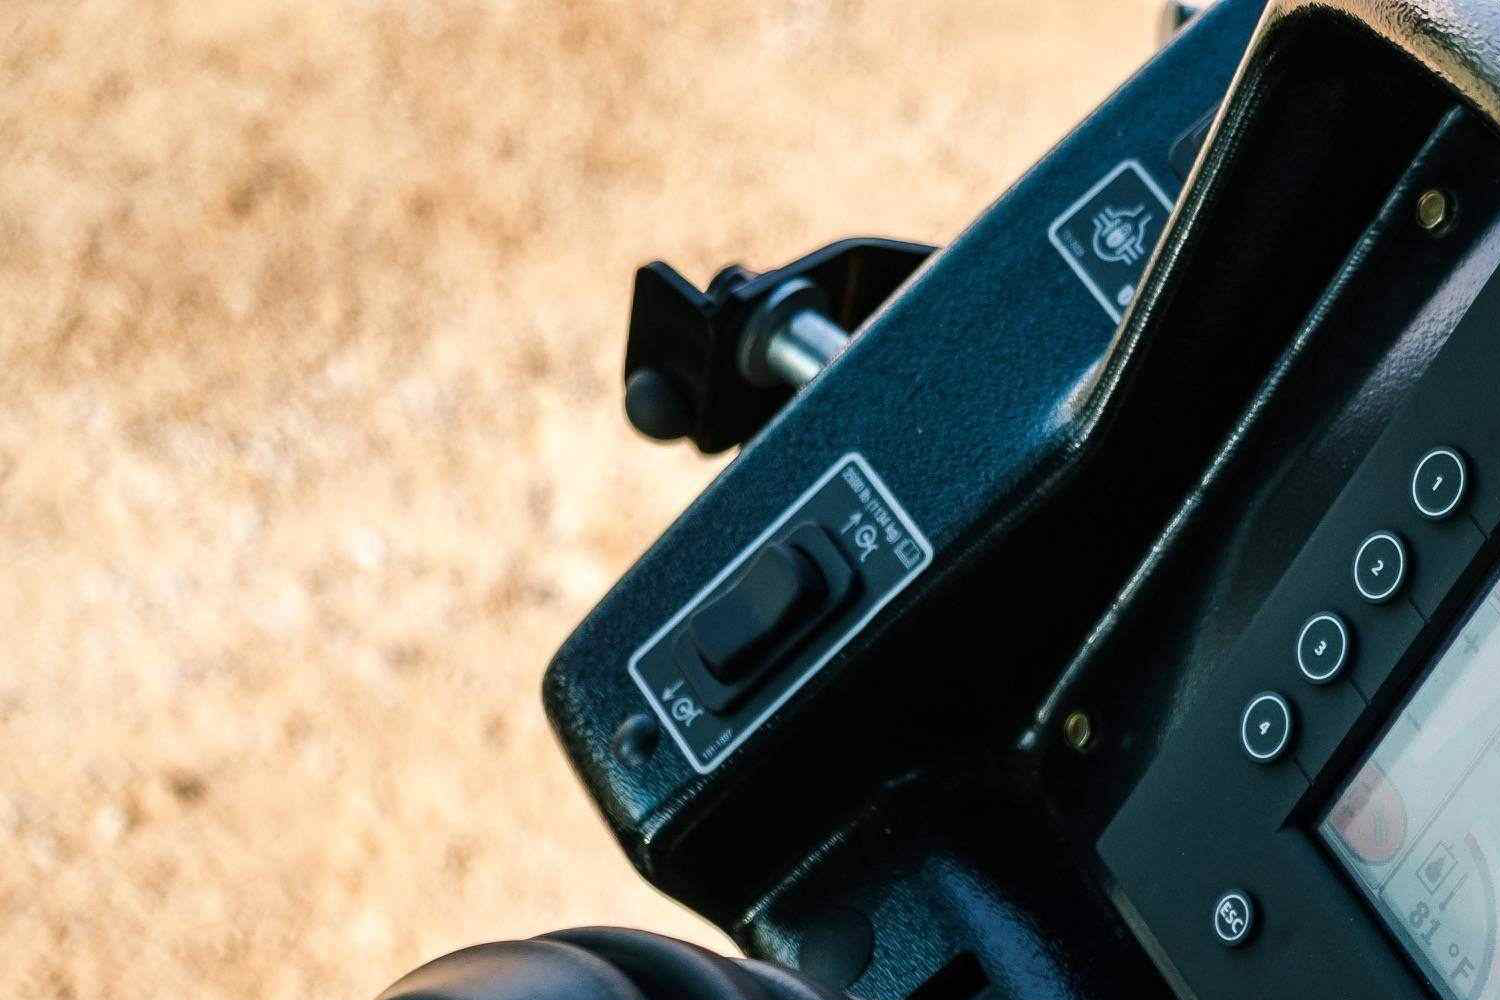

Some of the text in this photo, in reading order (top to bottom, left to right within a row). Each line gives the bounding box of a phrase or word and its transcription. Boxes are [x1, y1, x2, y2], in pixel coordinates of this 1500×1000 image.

[1432, 476, 1443, 491] 1
[1371, 559, 1384, 576] 2
[1314, 640, 1327, 656] 3
[1258, 721, 1271, 735] 4
[1219, 901, 1244, 935] ESC
[1409, 900, 1441, 945] 81
